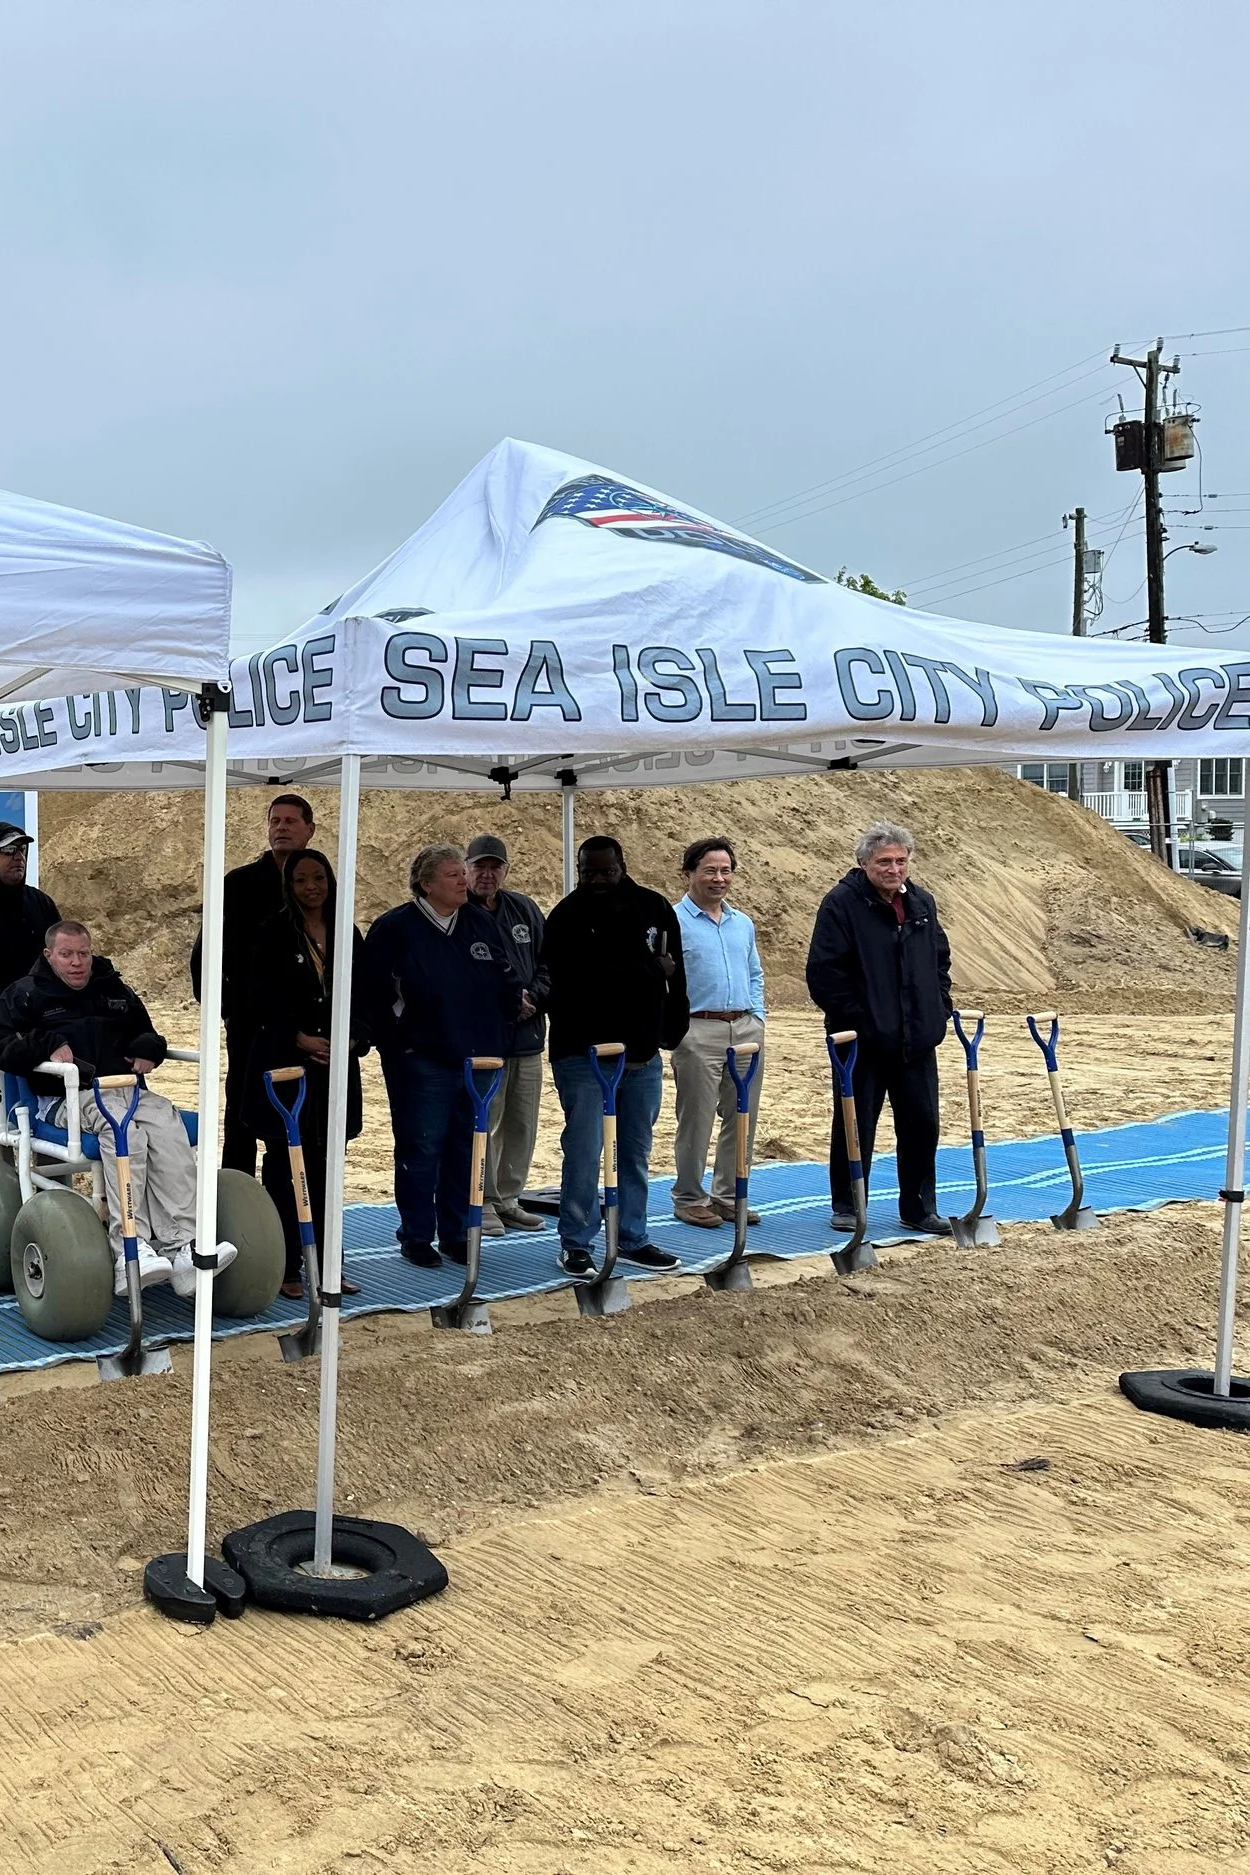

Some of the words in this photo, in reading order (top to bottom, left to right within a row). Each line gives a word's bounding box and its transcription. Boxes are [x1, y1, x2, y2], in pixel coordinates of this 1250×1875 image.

[381, 631, 582, 722] SEA
[612, 644, 807, 723] ISLE
[834, 647, 998, 727] CITY
[1018, 661, 1250, 732] POLICE
